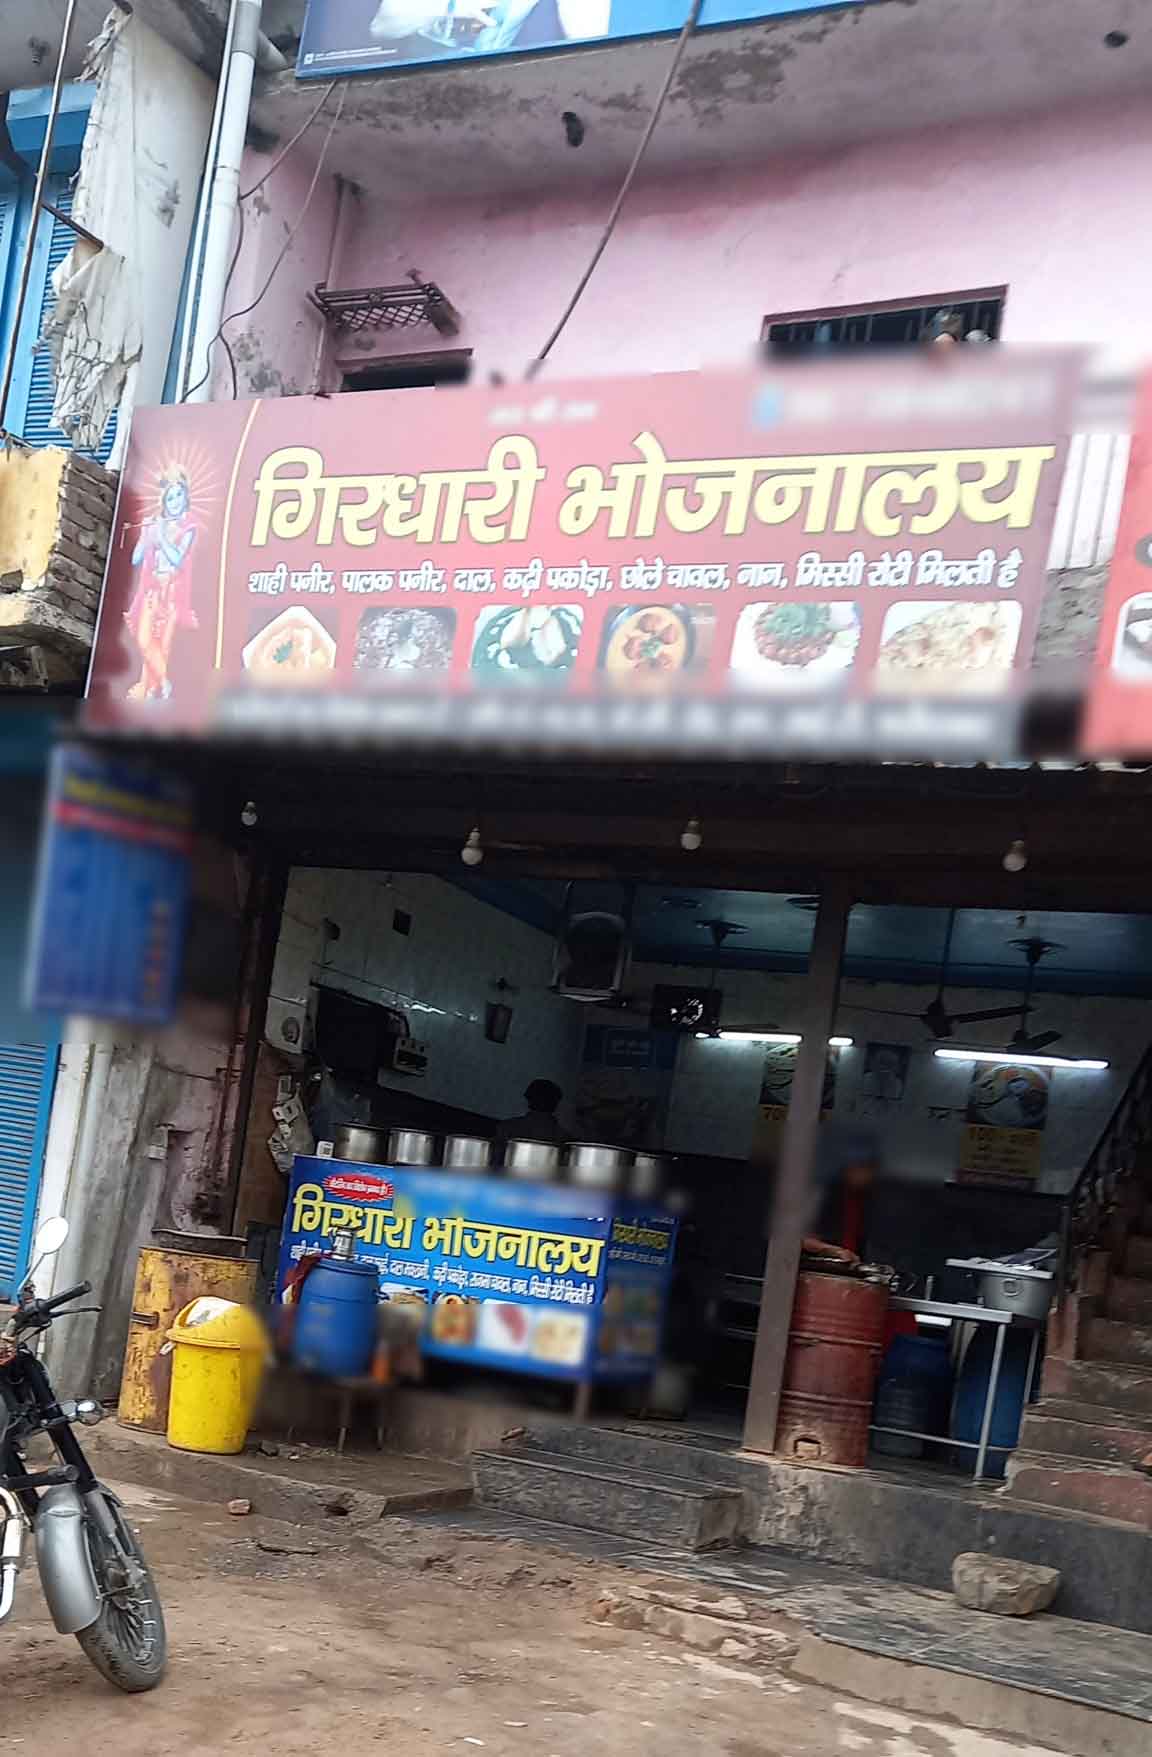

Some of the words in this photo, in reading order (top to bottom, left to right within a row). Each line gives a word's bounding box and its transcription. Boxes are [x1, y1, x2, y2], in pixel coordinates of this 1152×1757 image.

[250, 434, 546, 547] गिरधारी
[558, 431, 1057, 537] भोजनालय
[248, 562, 288, 594] शाही
[342, 569, 396, 593] पालक
[795, 550, 865, 587] मिस्सी
[867, 550, 914, 586] रोटी
[915, 549, 997, 585] मिलती
[997, 547, 1023, 588] है
